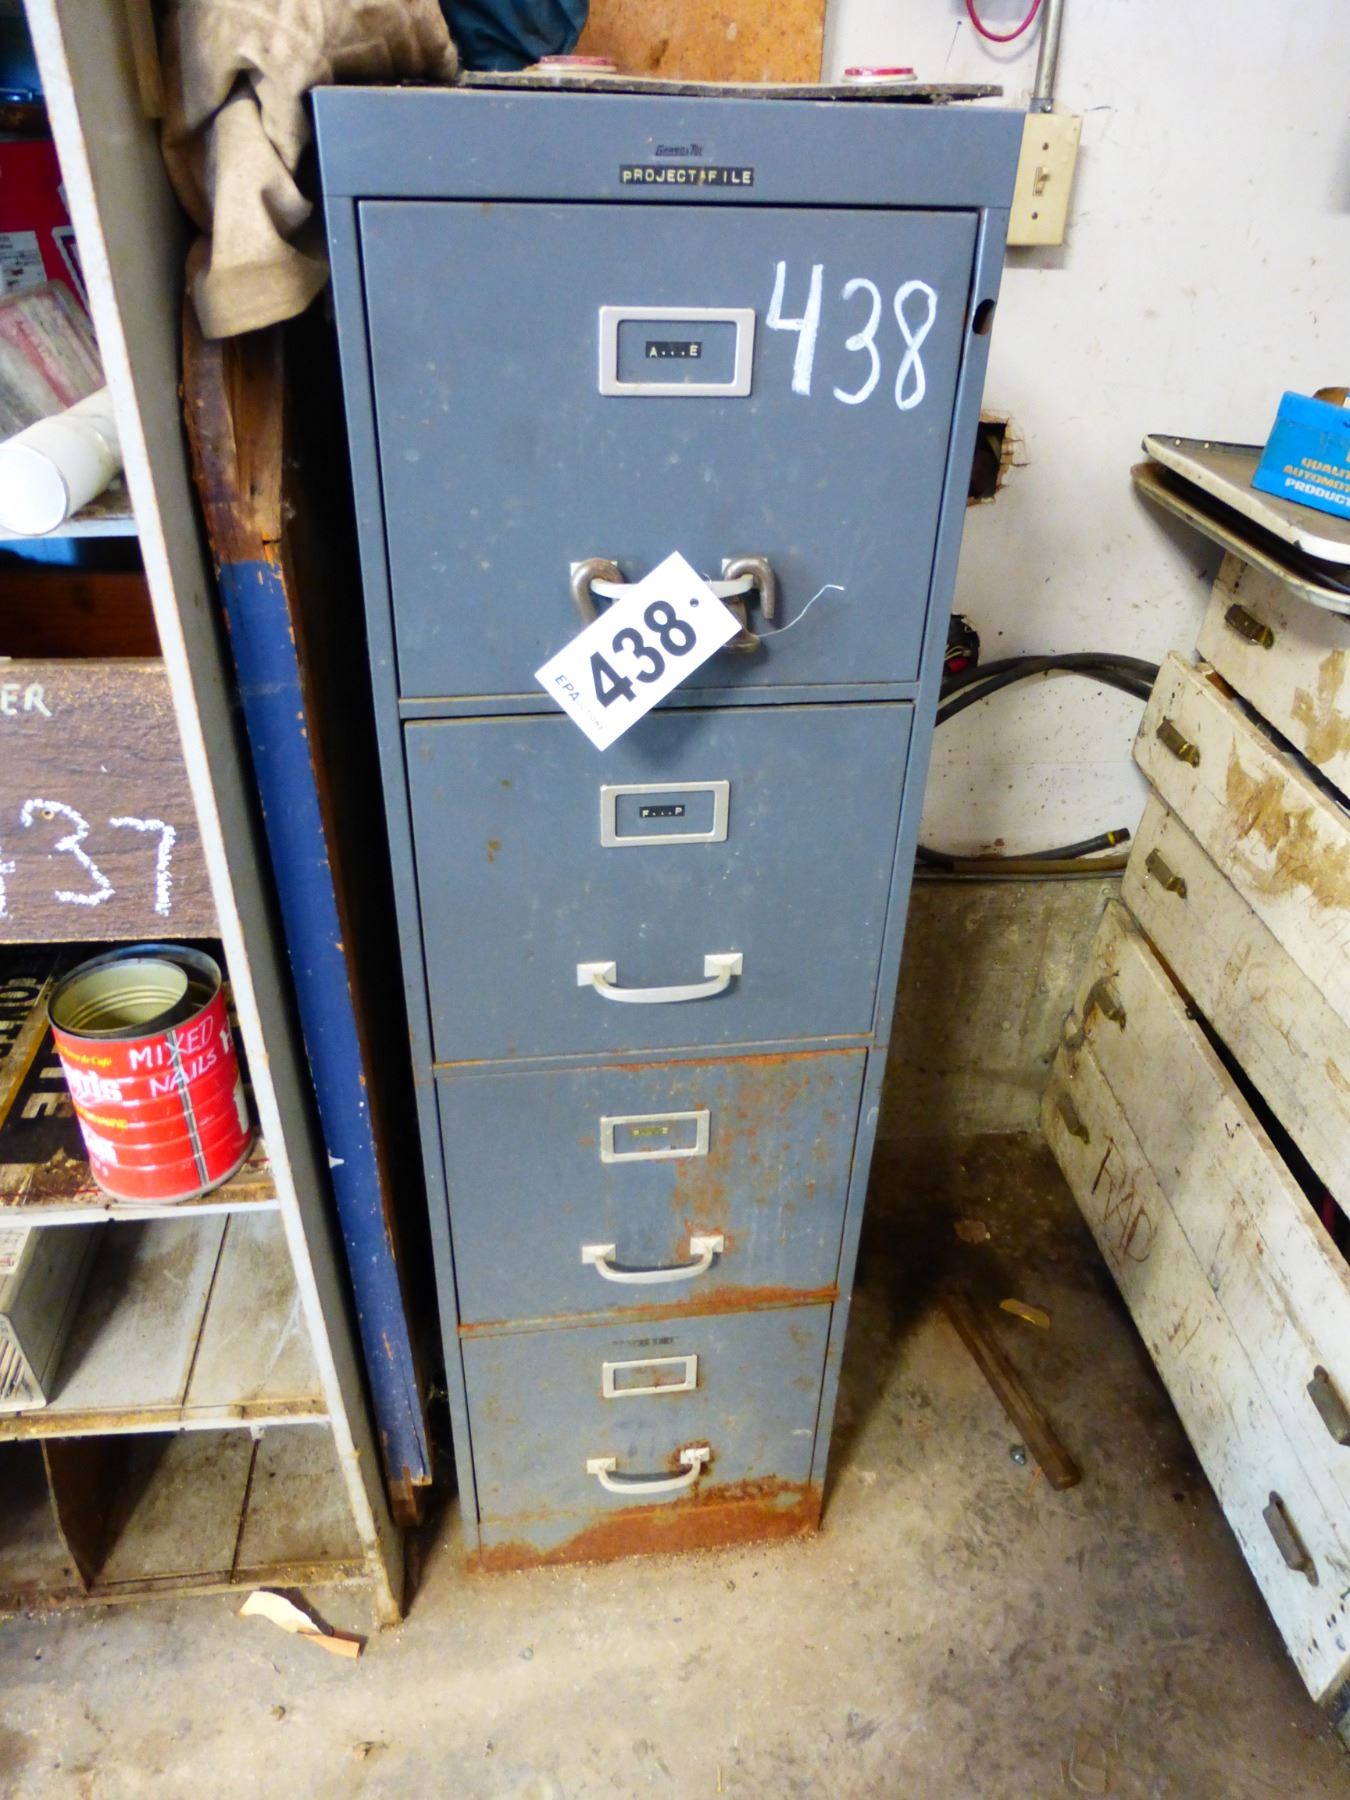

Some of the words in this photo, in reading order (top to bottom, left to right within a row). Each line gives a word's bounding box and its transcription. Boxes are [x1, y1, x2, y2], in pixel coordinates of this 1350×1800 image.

[708, 170, 751, 184] FILE
[765, 260, 938, 411] 438
[590, 600, 697, 708] 438
[554, 674, 580, 702] EPA
[129, 1015, 214, 1071] MIXED
[149, 1048, 217, 1098] NAILS
